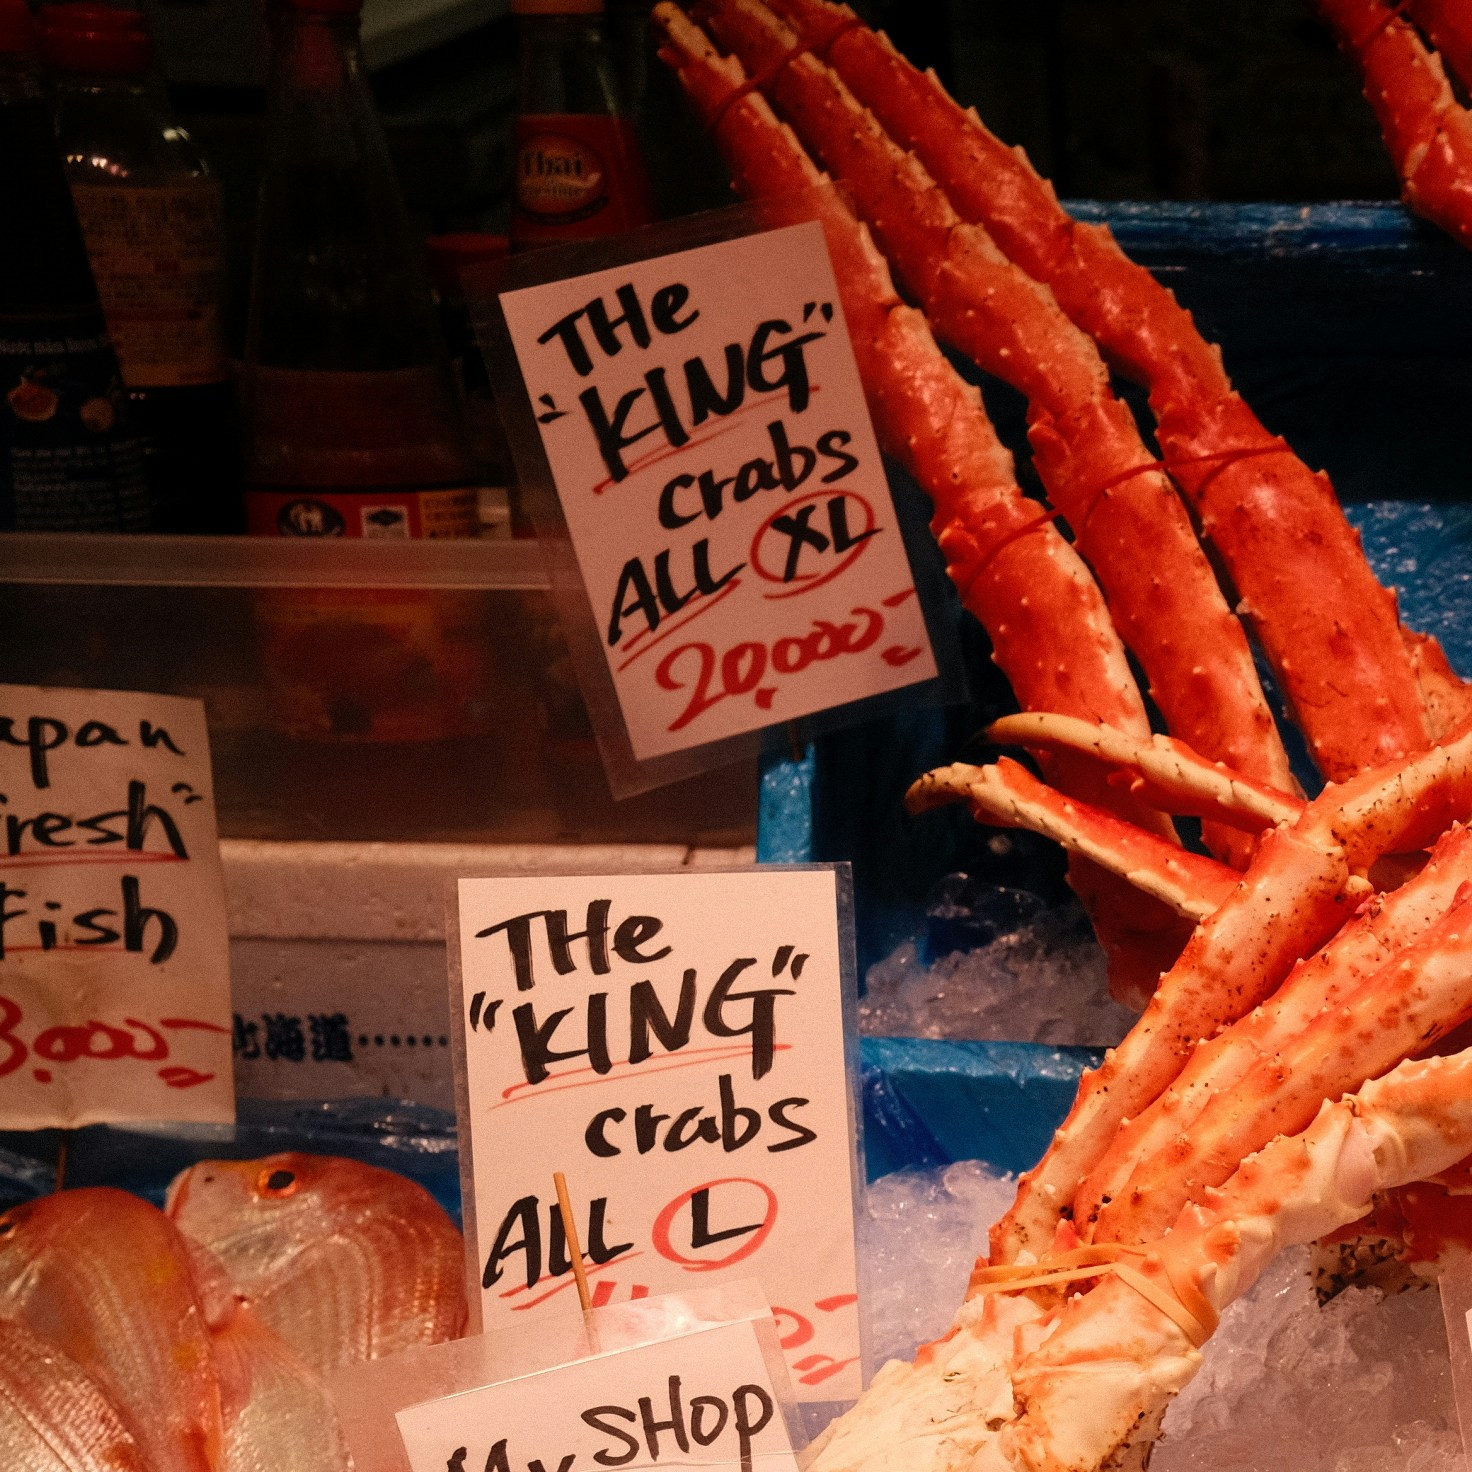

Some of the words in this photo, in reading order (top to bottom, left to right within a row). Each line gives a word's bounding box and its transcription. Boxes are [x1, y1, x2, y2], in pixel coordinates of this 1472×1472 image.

[607, 539, 746, 646] ALL
[769, 496, 884, 583] XL
[0, 716, 185, 789] apan
[0, 780, 204, 860] resh"
[482, 1195, 634, 1290] ALL
[690, 1187, 765, 1249] L
